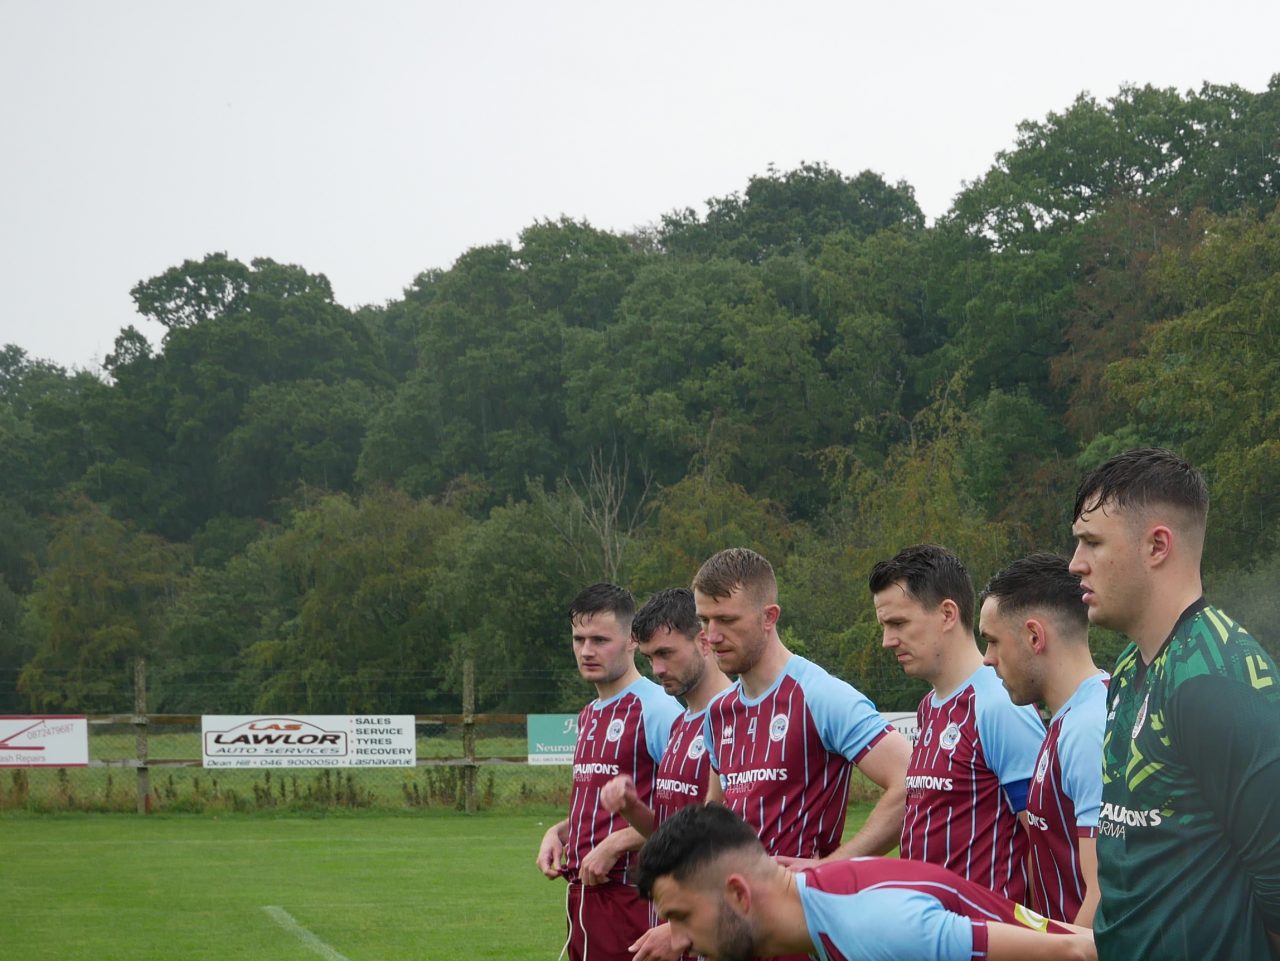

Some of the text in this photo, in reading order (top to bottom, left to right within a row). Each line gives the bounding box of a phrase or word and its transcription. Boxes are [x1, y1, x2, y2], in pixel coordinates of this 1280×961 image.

[355, 717, 392, 725] SALES
[248, 723, 303, 731] LAS
[355, 727, 403, 735] SERVICE
[586, 718, 598, 741] 2
[747, 716, 758, 743] 4
[923, 719, 933, 747] 6
[214, 733, 342, 745] LAWLOR
[356, 737, 393, 745] TYRES
[216, 746, 340, 754] AUTO SERVICES
[356, 747, 413, 755] RECOVERY
[727, 768, 788, 786] STAUNTON'S
